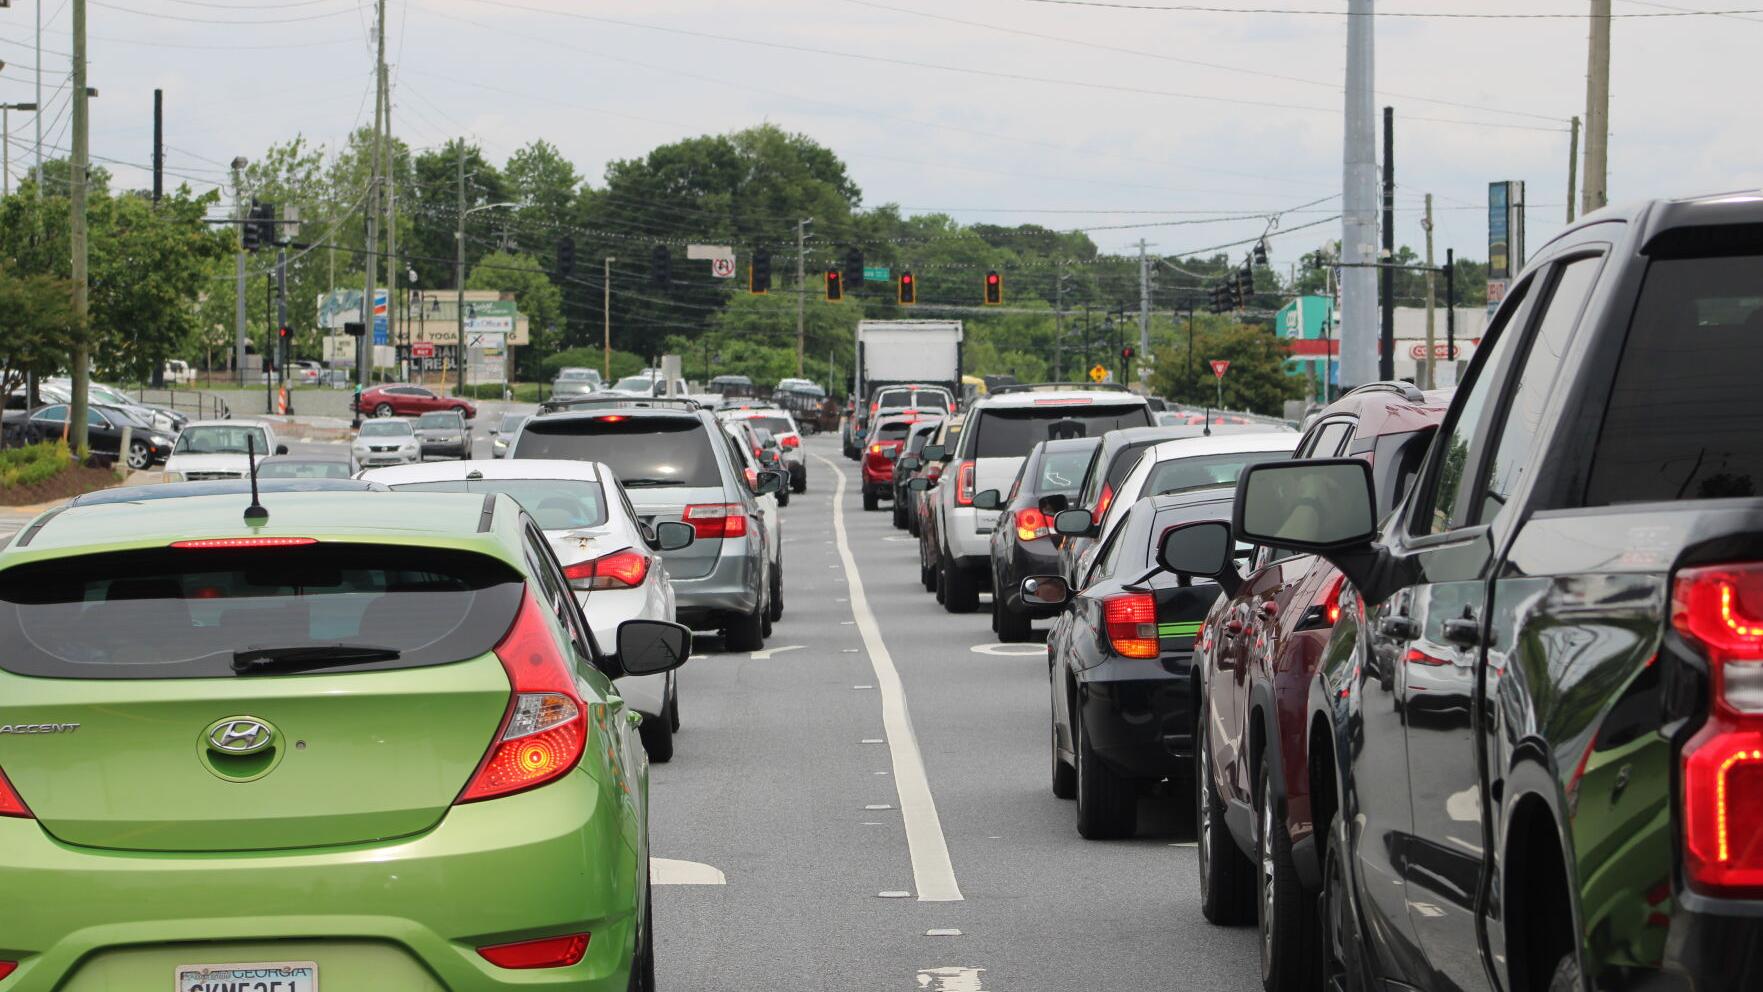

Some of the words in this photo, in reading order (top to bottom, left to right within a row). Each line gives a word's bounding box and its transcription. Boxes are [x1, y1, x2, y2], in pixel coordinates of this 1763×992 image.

[429, 332, 457, 340] YOGA
[0, 723, 80, 734] ACCENT
[232, 968, 307, 979] GEORGIA
